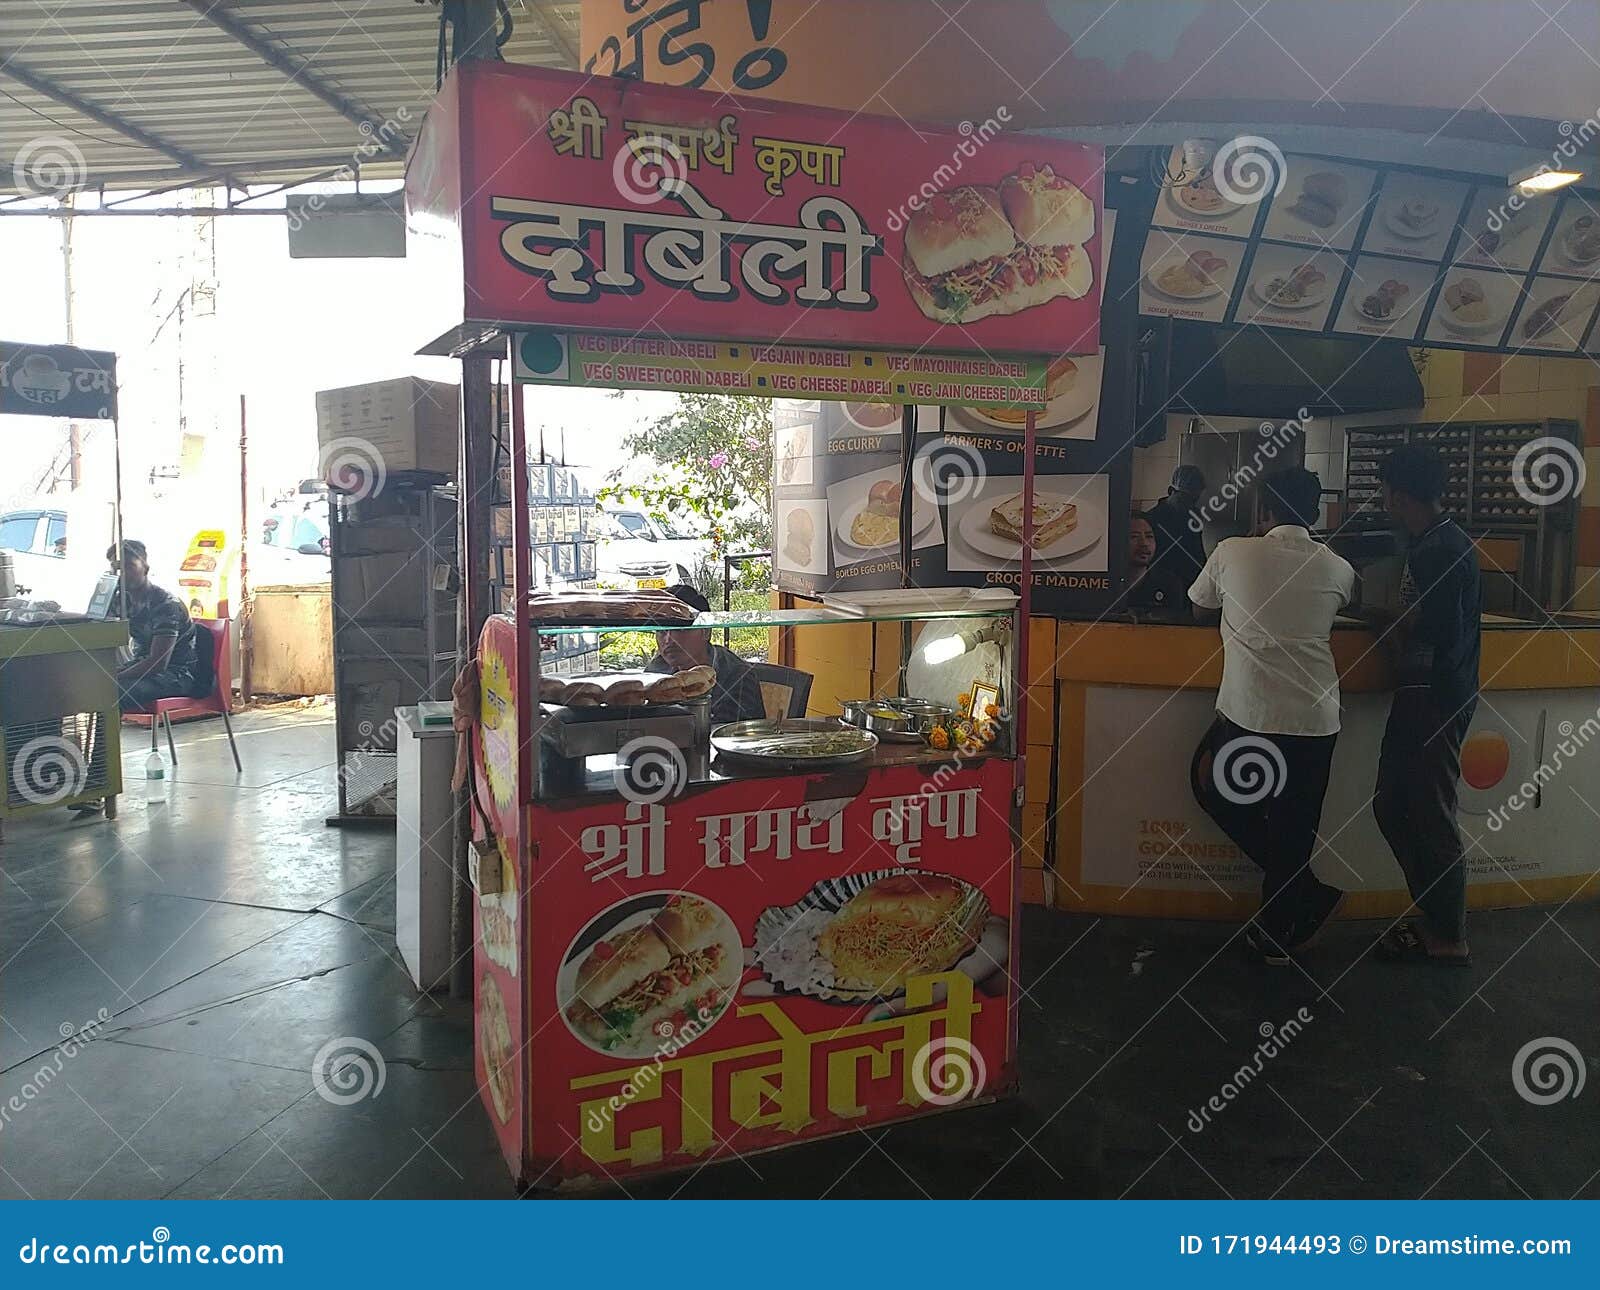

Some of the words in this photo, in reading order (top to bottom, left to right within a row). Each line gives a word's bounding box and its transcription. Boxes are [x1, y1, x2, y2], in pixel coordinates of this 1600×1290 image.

[547, 97, 608, 160] श्री
[624, 114, 738, 174] समर्थ
[753, 136, 845, 196] कृपा
[490, 177, 885, 311] दाबेली
[577, 335, 607, 352] VEG
[611, 338, 665, 357] BUTTER
[670, 342, 717, 359] DABELI
[809, 351, 851, 368] DABELI
[887, 356, 910, 372] VEG
[913, 358, 986, 375] MAYONNAISE
[584, 363, 612, 380] VEG
[617, 366, 701, 385] SWEETCORN
[705, 371, 751, 388] DABELI
[771, 374, 796, 391] VEG
[800, 376, 848, 393] CHEESE
[850, 379, 892, 395] DABELI
[909, 382, 931, 398] VEG
[935, 384, 961, 399] JAIN
[963, 386, 1007, 401] CHEESE
[1009, 388, 1047, 403] DABELI
[828, 440, 845, 452] EGG
[847, 436, 881, 450] CURRY
[943, 434, 1003, 451] FARMER'S
[835, 567, 859, 579] BOILED
[861, 564, 876, 575] EGG
[877, 557, 920, 573] OMELTE
[1046, 575, 1110, 590] MADAME
[579, 801, 672, 883] श्री
[870, 786, 983, 864] कृपा
[569, 969, 982, 1167] दाबेली
